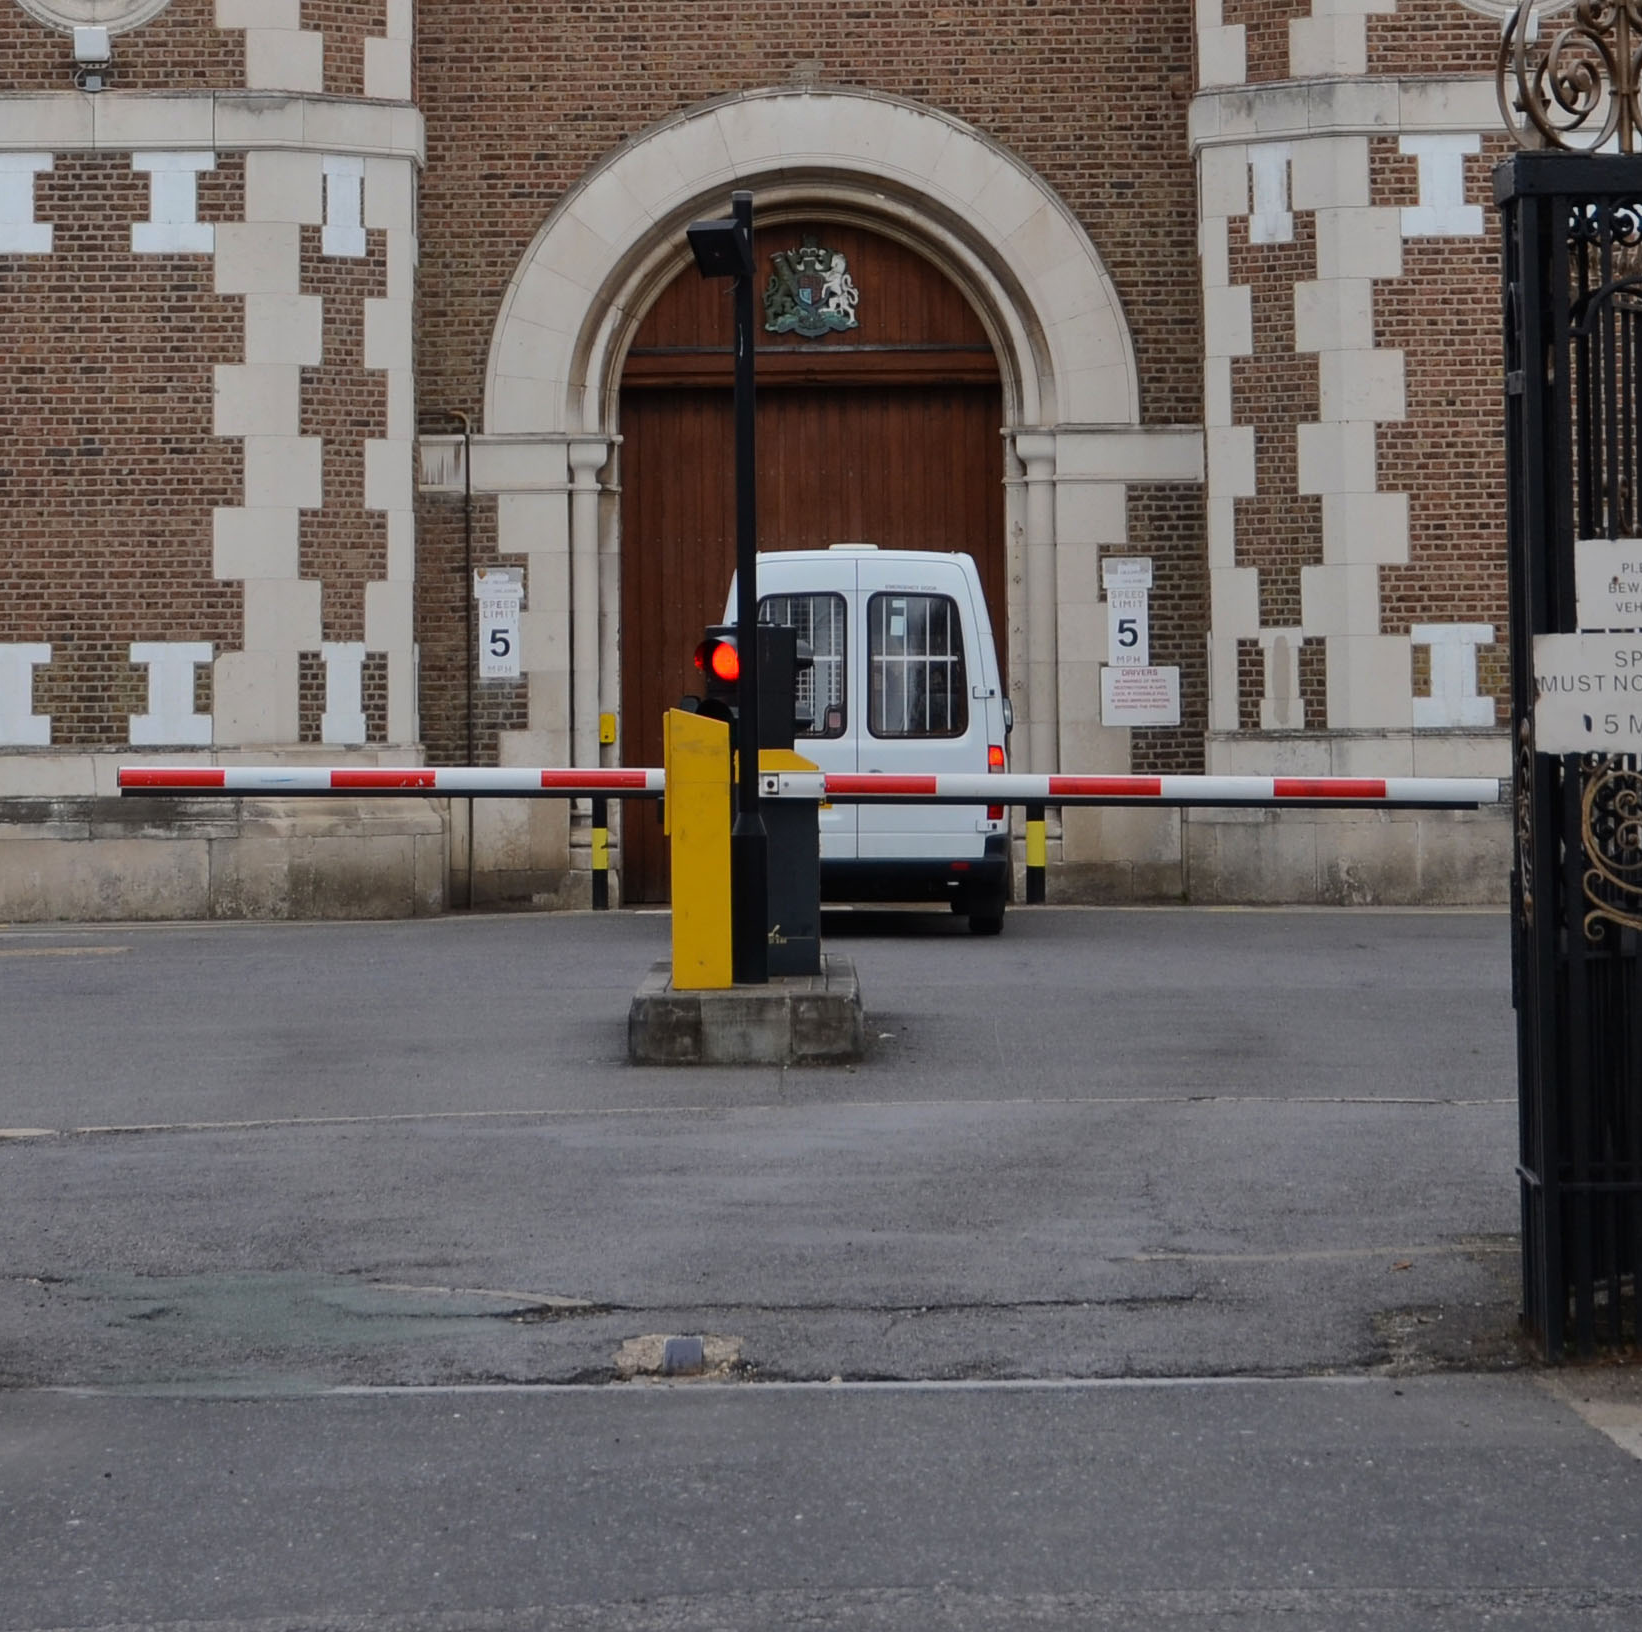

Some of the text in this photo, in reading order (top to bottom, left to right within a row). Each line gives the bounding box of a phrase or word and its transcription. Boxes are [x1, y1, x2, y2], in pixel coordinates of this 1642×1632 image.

[1110, 590, 1145, 599] SPEED
[482, 600, 517, 609] SPEED
[1112, 600, 1144, 609] LIMIT
[483, 610, 516, 619] LIMIT
[1117, 619, 1139, 647] 5
[490, 629, 511, 657] 5
[1116, 655, 1141, 664] MPH
[1540, 674, 1606, 693] MUST
